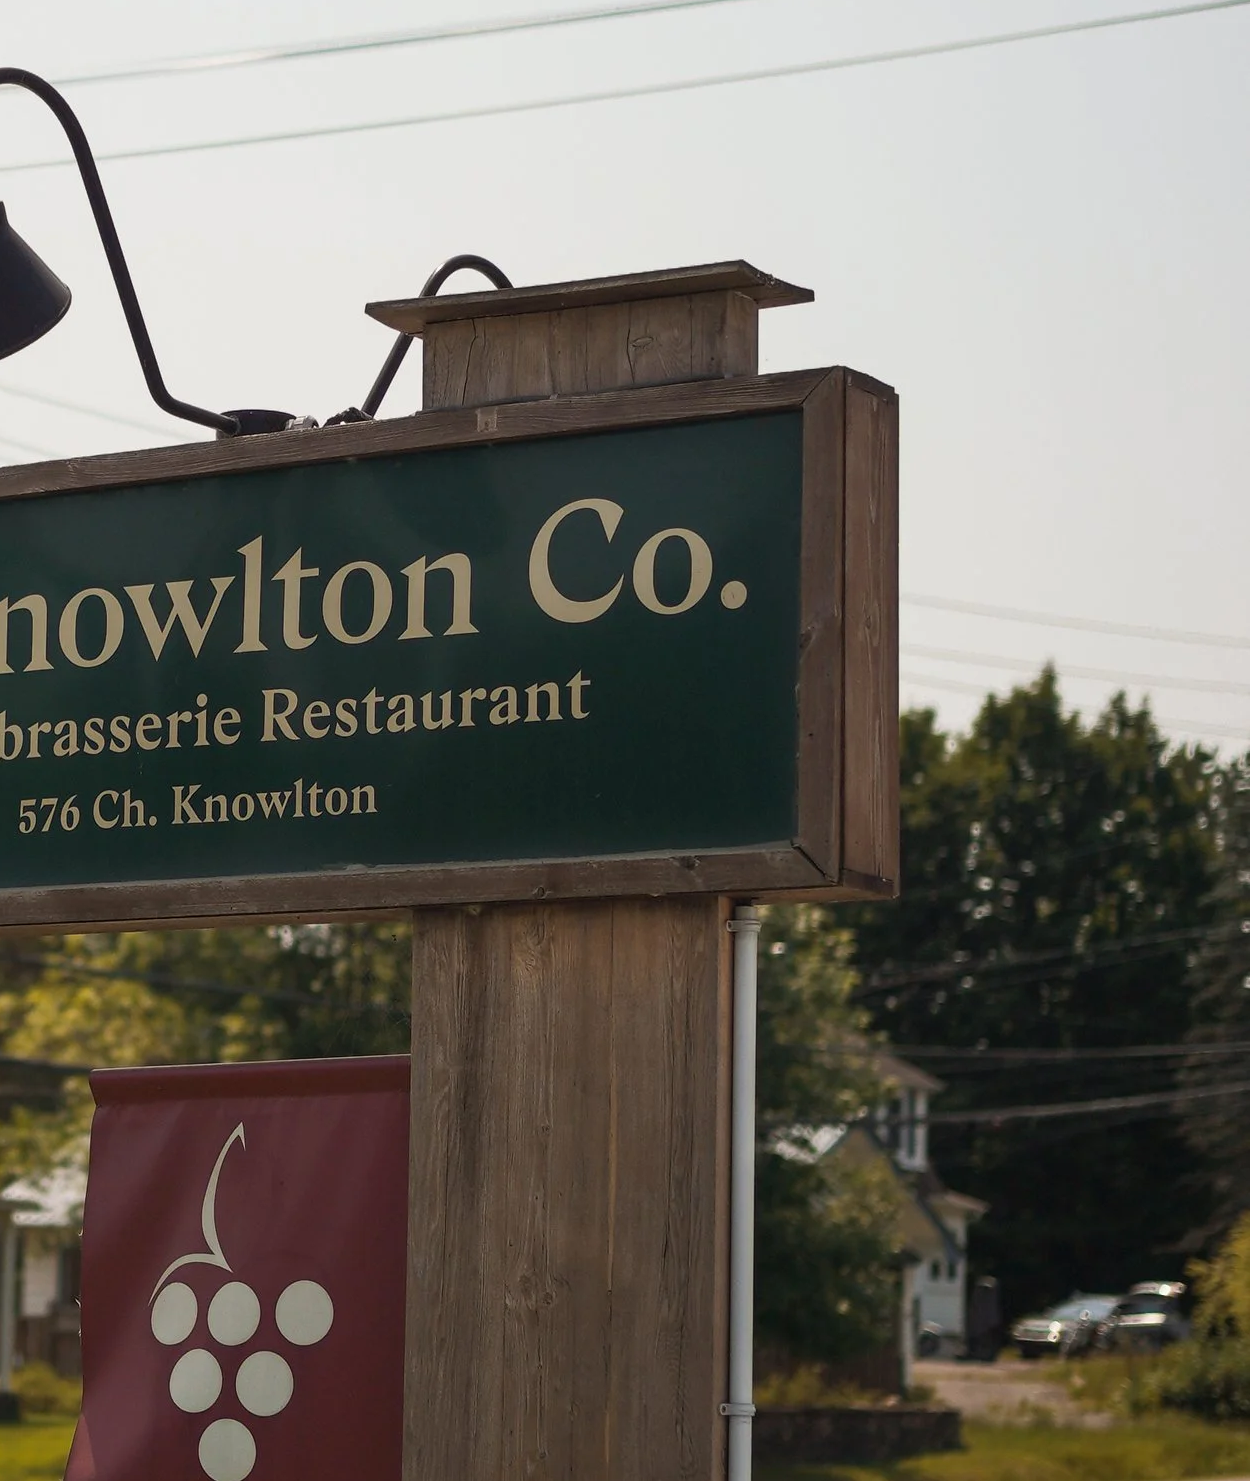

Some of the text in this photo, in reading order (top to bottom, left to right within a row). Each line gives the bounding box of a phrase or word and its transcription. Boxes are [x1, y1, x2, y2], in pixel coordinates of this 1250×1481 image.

[528, 498, 748, 623] Co.
[260, 670, 591, 742] Restaurant
[18, 778, 378, 834] 576 Ch. Knowlton
